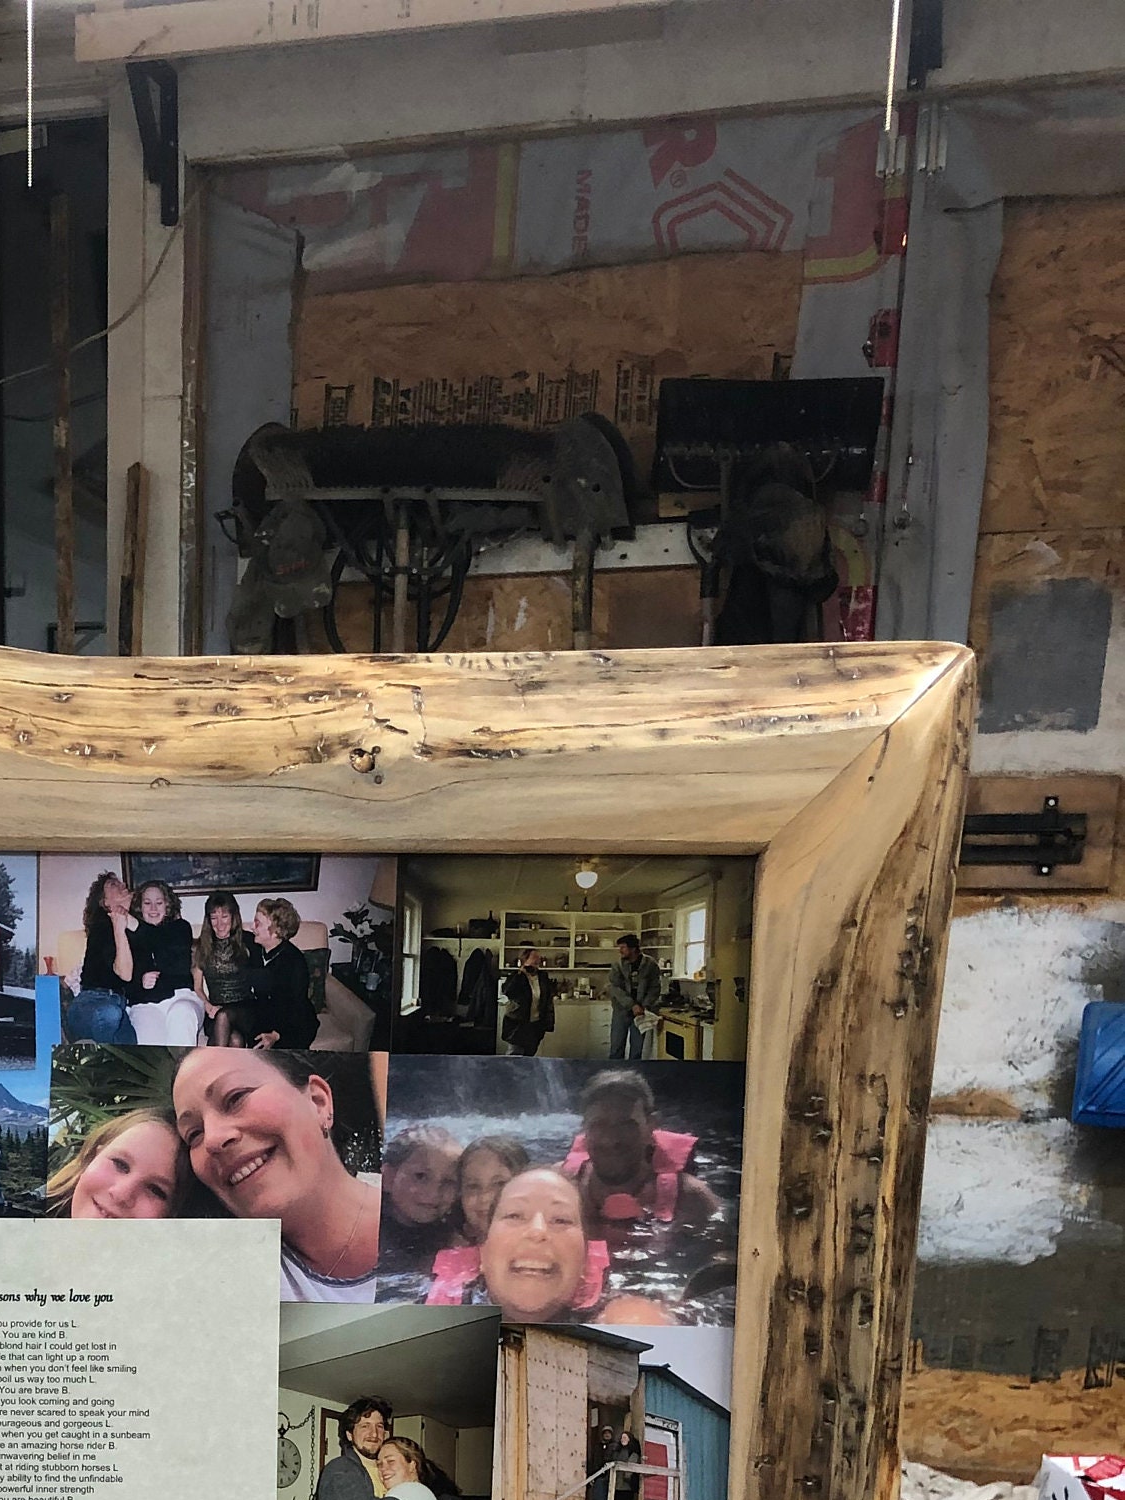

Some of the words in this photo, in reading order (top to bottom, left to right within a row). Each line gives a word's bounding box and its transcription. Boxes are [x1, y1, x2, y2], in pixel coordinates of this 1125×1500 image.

[24, 1289, 47, 1306] why
[50, 1293, 66, 1301] we
[69, 1289, 91, 1302] love
[94, 1293, 114, 1306] you
[0, 1341, 23, 1349] blond
[25, 1341, 42, 1349] hair
[44, 1341, 47, 1350] I
[49, 1341, 73, 1350] could
[75, 1341, 89, 1351] get
[91, 1341, 107, 1350] lost
[109, 1341, 117, 1350] in
[8, 1352, 25, 1361] that
[45, 1353, 63, 1363] light
[66, 1354, 77, 1363] up
[4, 1363, 27, 1372] when
[29, 1365, 46, 1374] you
[48, 1363, 69, 1372] don't
[71, 1363, 87, 1372] feel
[90, 1363, 105, 1372] like
[107, 1364, 137, 1374] smiling
[0, 1398, 16, 1407] you
[18, 1397, 37, 1405] look
[38, 1397, 70, 1407] coming
[72, 1397, 89, 1405] and
[91, 1397, 115, 1407] going
[37, 1408, 66, 1416] scared
[68, 1408, 77, 1416] to
[79, 1408, 105, 1418] speak
[107, 1410, 127, 1418] your
[128, 1408, 150, 1417] mind
[1, 1429, 24, 1438] when
[27, 1431, 43, 1440] you
[45, 1430, 59, 1440] get
[61, 1430, 90, 1440] caught
[92, 1430, 100, 1438] in
[110, 1430, 151, 1439] sunbeam
[47, 1452, 70, 1460] belief
[72, 1452, 80, 1460] in
[7, 1473, 32, 1483] ability
[34, 1473, 42, 1482] to
[44, 1474, 60, 1482] find
[62, 1474, 77, 1482] the
[79, 1474, 123, 1482] unfindable
[36, 1484, 57, 1493] inner
[60, 1485, 94, 1495] strength
